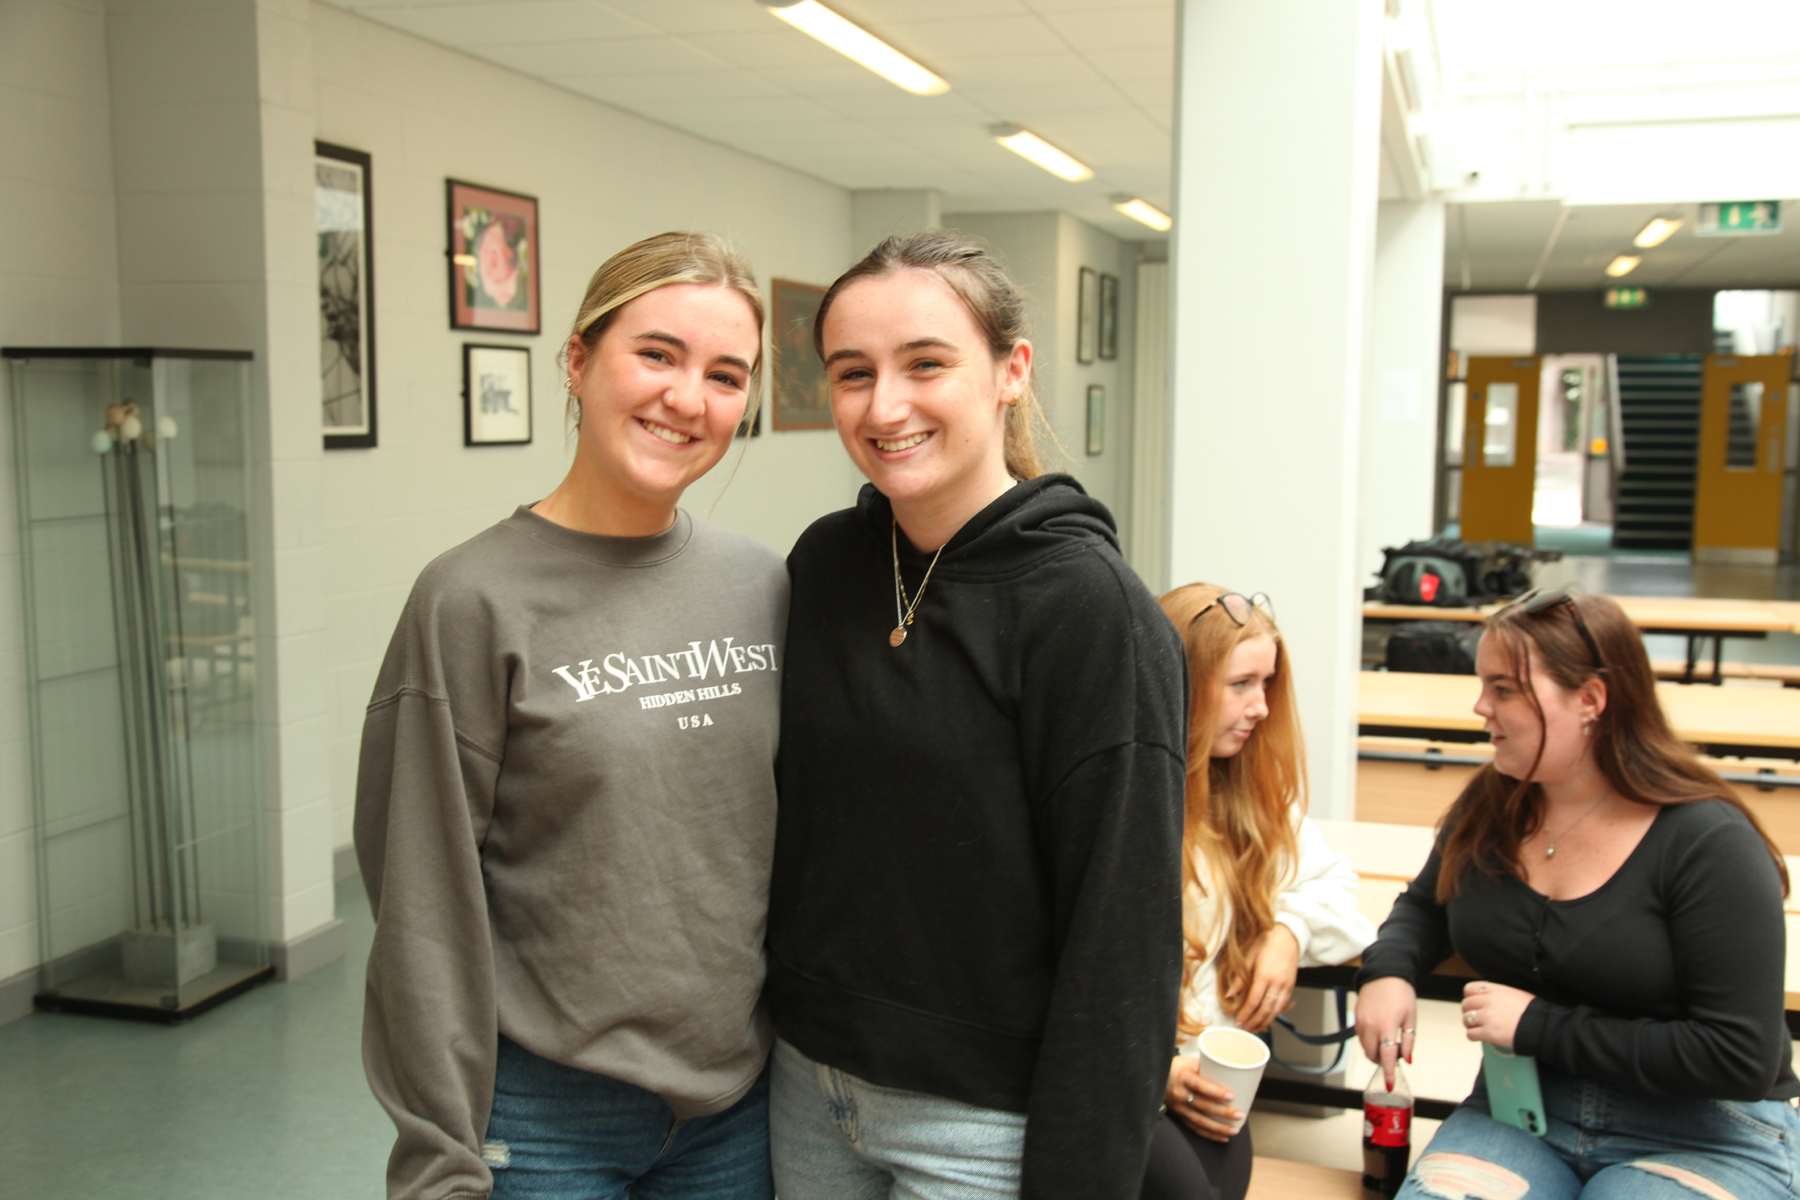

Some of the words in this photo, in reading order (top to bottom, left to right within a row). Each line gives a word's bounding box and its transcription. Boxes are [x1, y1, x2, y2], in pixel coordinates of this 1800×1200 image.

[639, 690, 695, 709] HIDDEN
[698, 682, 742, 701] HILLS
[677, 713, 714, 730] USA
